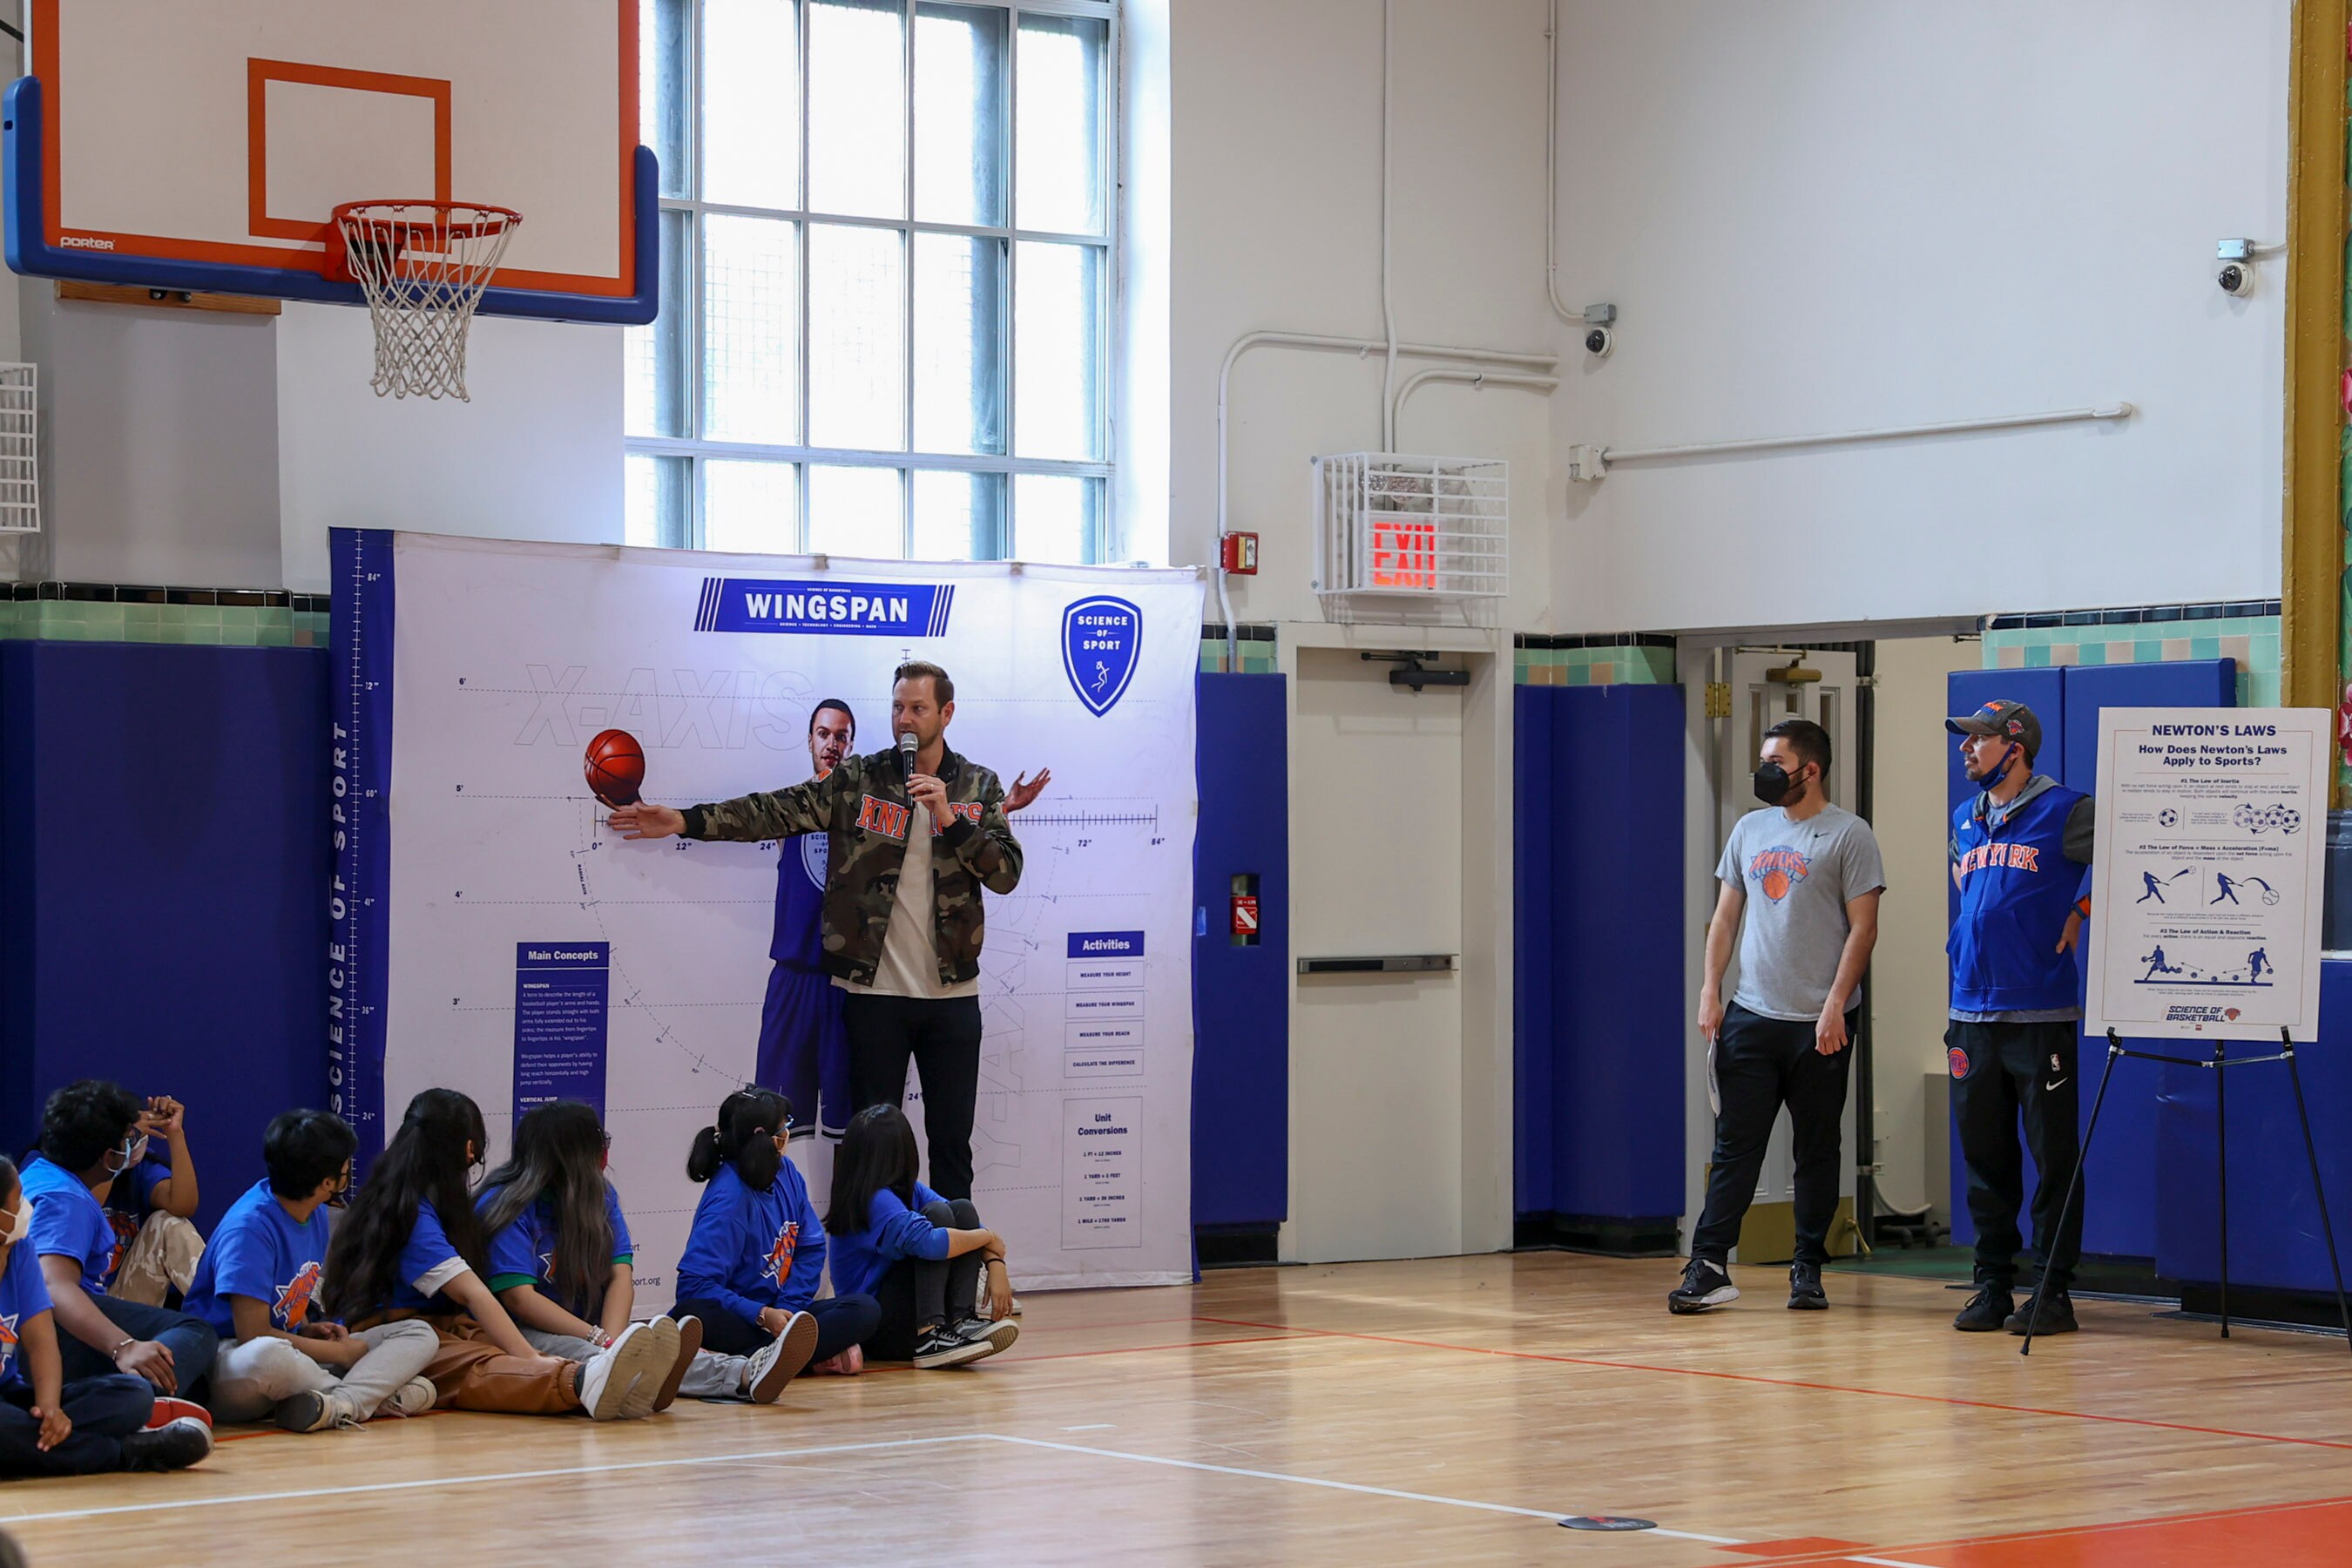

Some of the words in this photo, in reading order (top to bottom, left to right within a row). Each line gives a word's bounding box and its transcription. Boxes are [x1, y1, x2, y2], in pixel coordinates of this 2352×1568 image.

[1374, 523, 1436, 588] EXIT
[747, 594, 907, 622] WINGSPAN
[1078, 616, 1127, 625] SCIENCE
[1083, 641, 1120, 650] SPORT
[514, 664, 814, 751] X-AXIS
[2153, 725, 2229, 736] NEWTON'S
[2235, 725, 2276, 736] LAWS
[2139, 745, 2163, 754] How
[2167, 745, 2196, 754] Does
[2200, 745, 2253, 754] Newton's
[2257, 746, 2287, 754] Laws
[2164, 756, 2194, 767] Apply
[2199, 757, 2211, 765] to
[2215, 757, 2261, 766] Sports?
[333, 722, 348, 851] SPORT
[366, 789, 377, 798] 60"
[676, 842, 692, 851] 12"
[760, 842, 776, 851] 24"
[1083, 939, 1129, 951] Activities
[528, 951, 551, 960] Main
[554, 951, 598, 960] Concepts
[2167, 1014, 2225, 1022] BASKETBALL
[328, 942, 345, 1114] SCIENCE
[363, 1112, 375, 1120] 24"
[1095, 1114, 1111, 1122] Unit
[1078, 1126, 1127, 1136] Conversions
